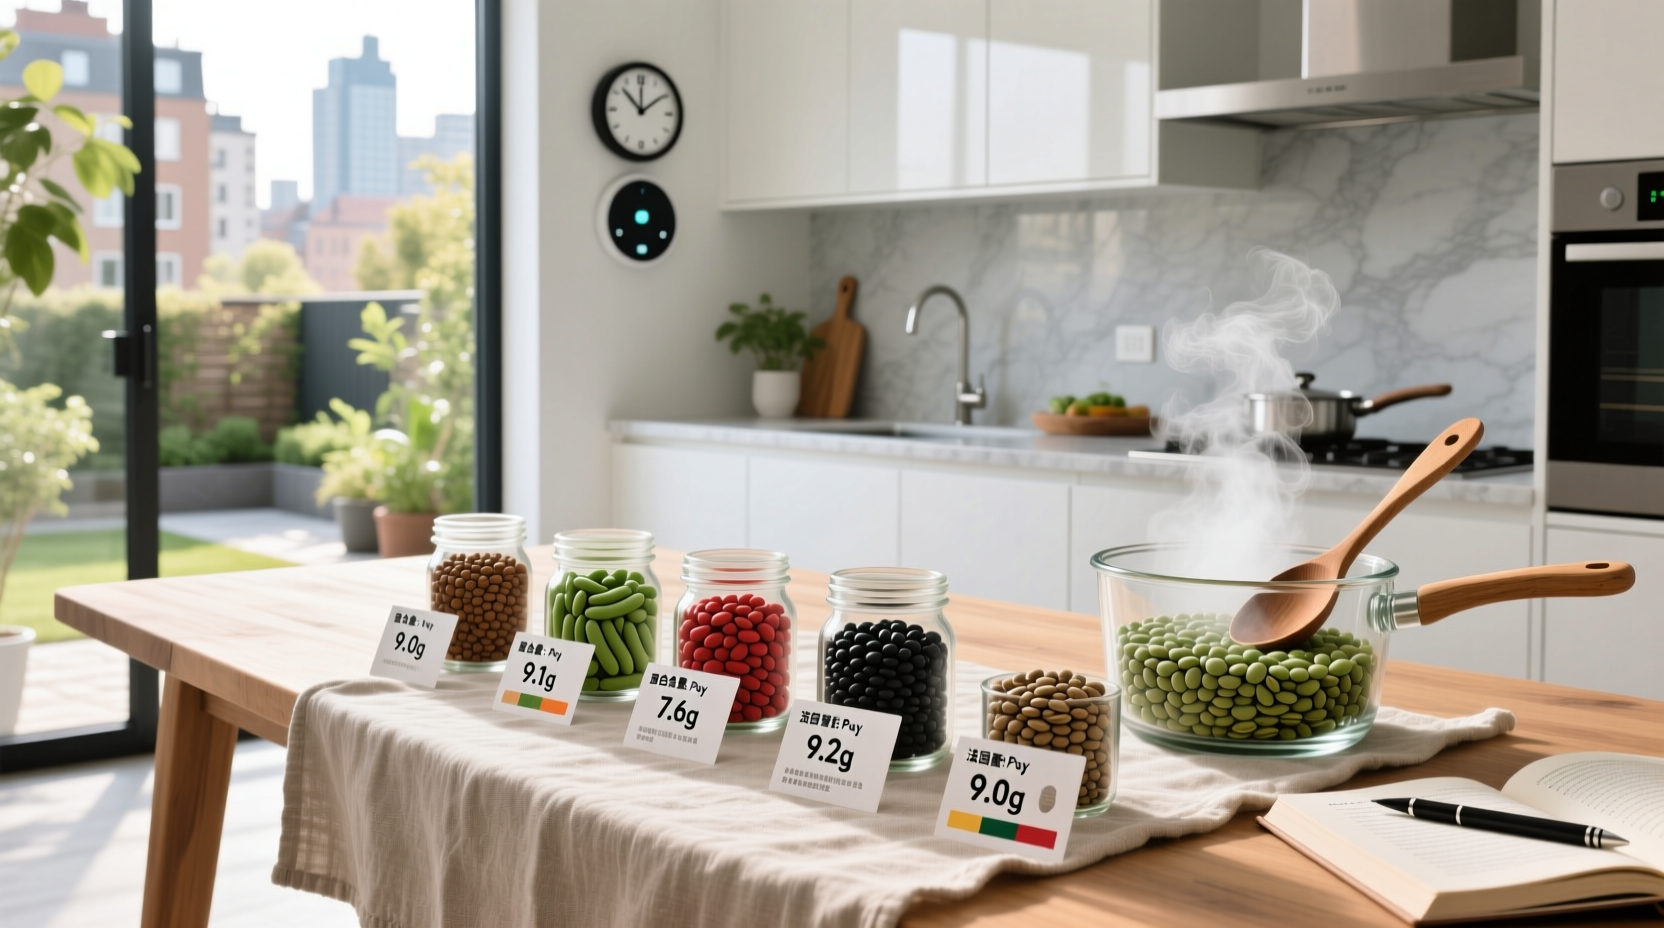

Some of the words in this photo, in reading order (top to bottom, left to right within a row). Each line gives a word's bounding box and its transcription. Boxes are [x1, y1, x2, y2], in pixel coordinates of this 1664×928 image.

[394, 631, 426, 661] 9.0g
[522, 661, 557, 693] 9.1g
[657, 695, 699, 731] 7.6g
[841, 718, 864, 737] Puy
[807, 734, 854, 773] 9.2g
[970, 773, 1026, 815] 9.0g
